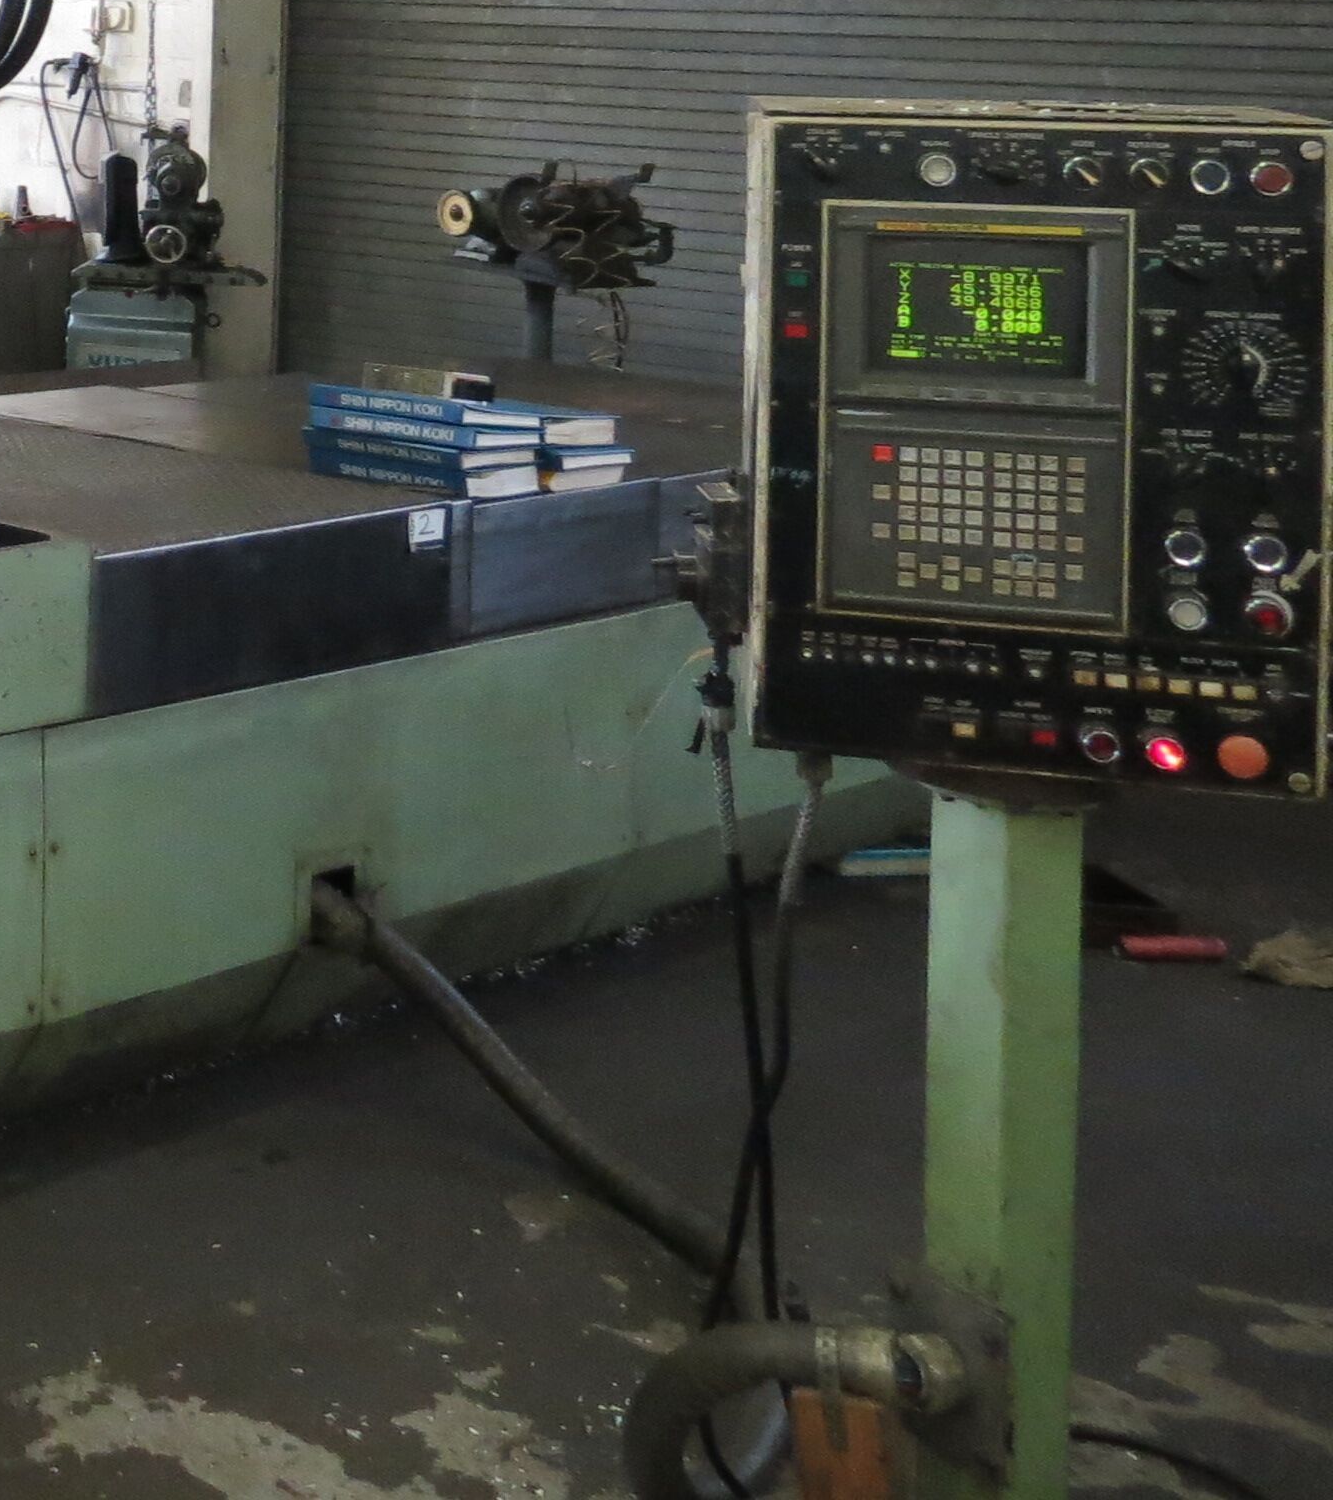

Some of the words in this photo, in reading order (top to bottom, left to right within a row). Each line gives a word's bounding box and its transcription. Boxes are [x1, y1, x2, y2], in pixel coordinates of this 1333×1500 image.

[898, 268, 911, 280] X
[898, 280, 911, 292] Y
[949, 283, 1043, 298] 45.3556
[898, 292, 911, 304] Z
[896, 304, 912, 316] A
[974, 319, 1043, 334] 0.000
[340, 393, 368, 408] SHIN
[369, 397, 412, 414] NIPPON
[413, 402, 444, 418] KOKI
[343, 415, 374, 432] SHIN
[375, 420, 420, 438] NIPPON
[421, 424, 455, 443] KOKI
[418, 512, 436, 536] 2
